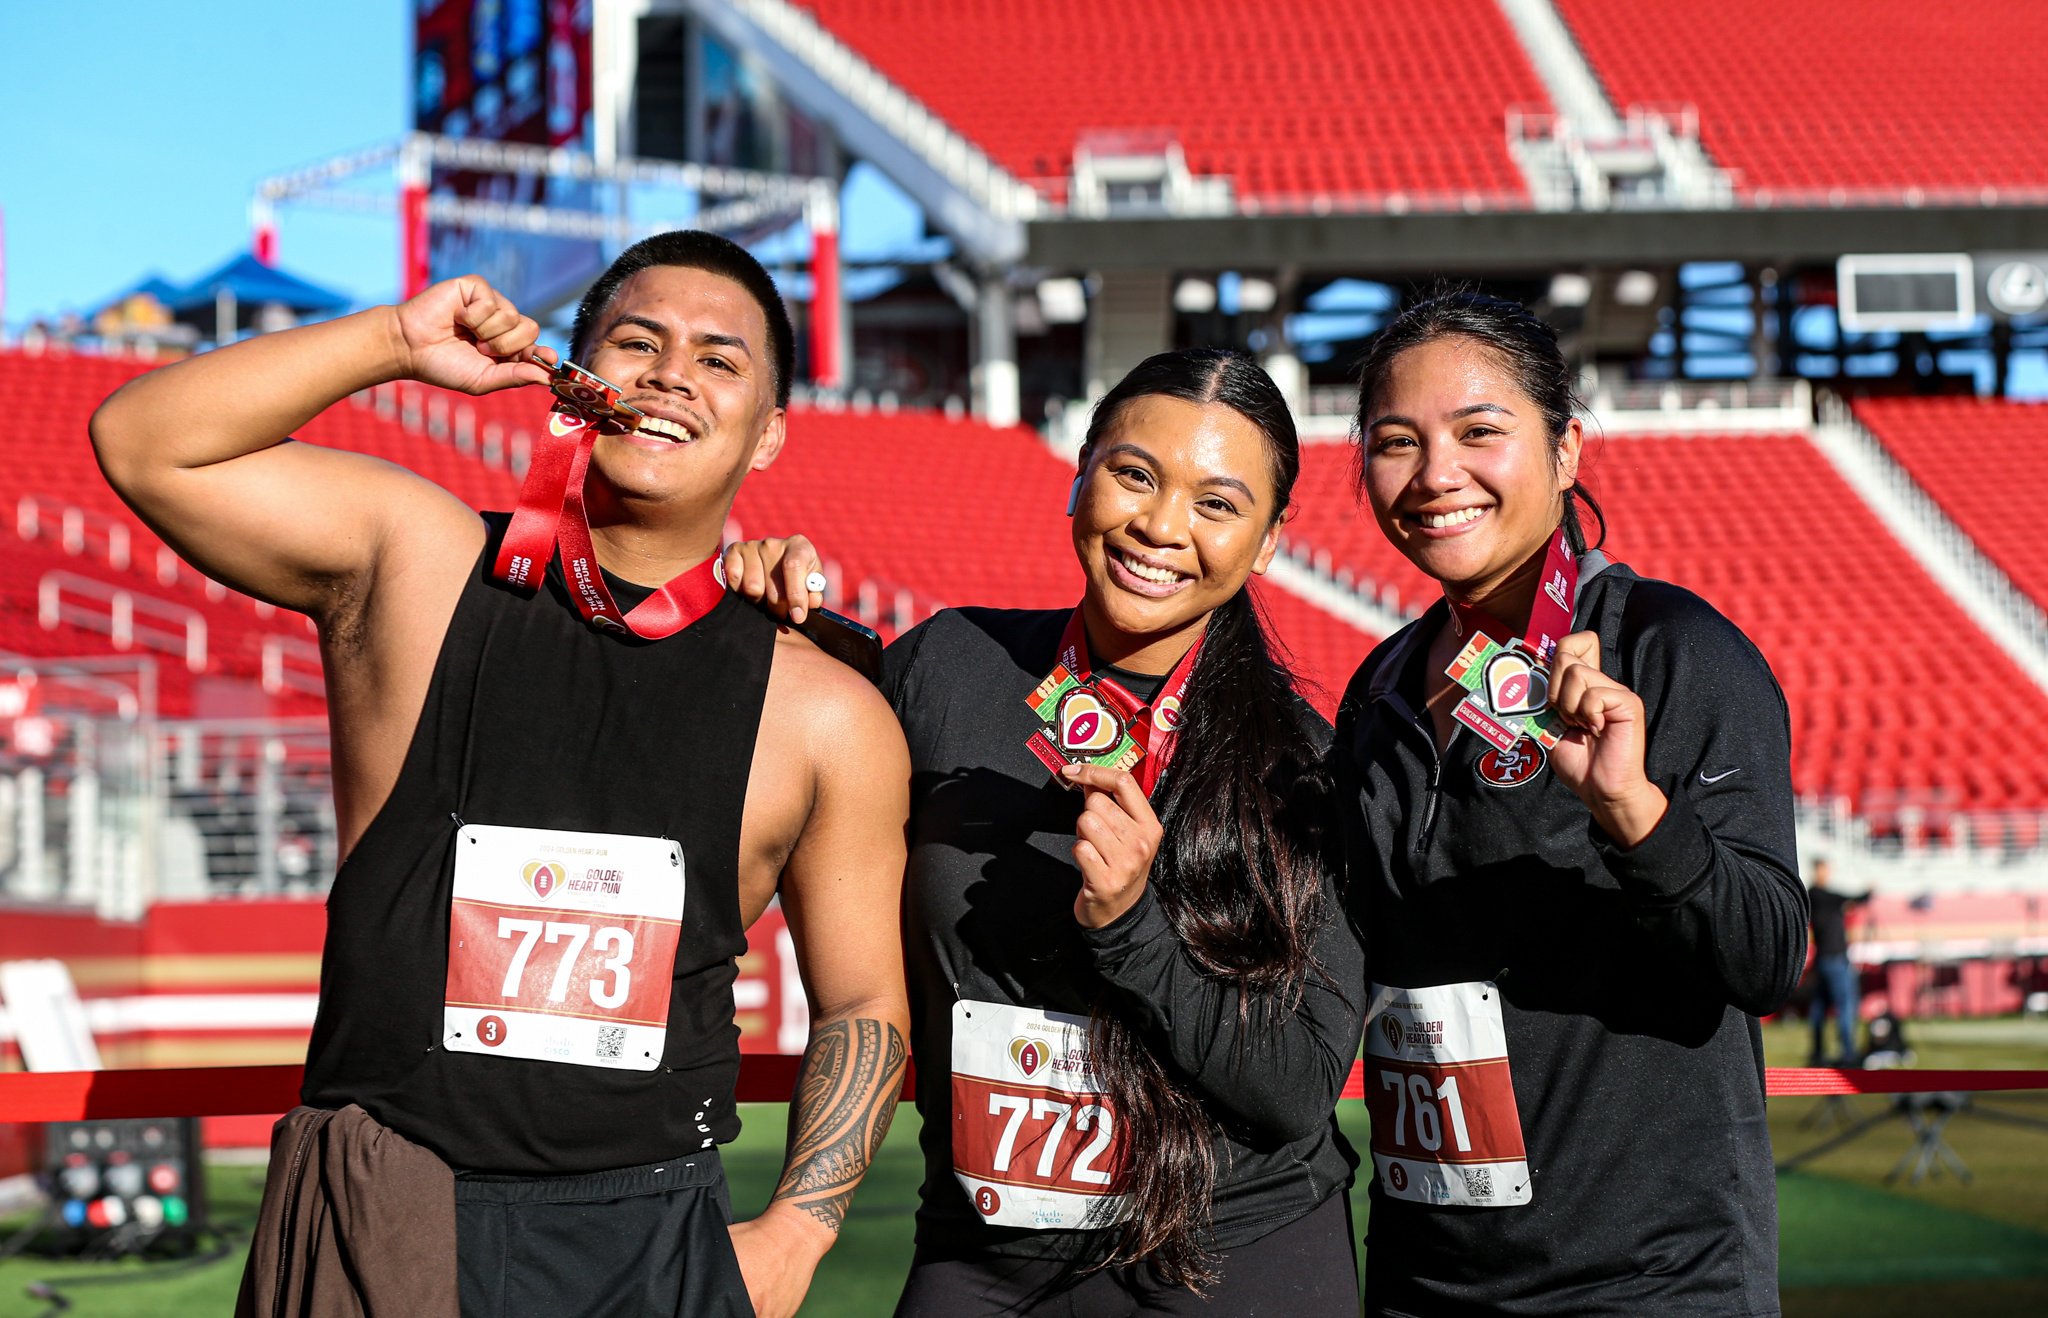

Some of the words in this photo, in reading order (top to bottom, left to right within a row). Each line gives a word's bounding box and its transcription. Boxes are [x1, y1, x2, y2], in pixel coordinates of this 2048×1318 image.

[519, 557, 532, 581] FUND
[572, 559, 588, 596] GOLDEN
[579, 557, 592, 583] FUND
[585, 596, 599, 612] THE
[587, 585, 606, 611] HEART
[1069, 645, 1077, 668] FUND
[1176, 682, 1189, 698] THE
[1043, 727, 1057, 742] 2024
[586, 868, 624, 883] GOLDEN
[568, 879, 602, 893] HEART
[600, 882, 621, 895] RUN
[498, 916, 634, 1009] 773
[485, 1021, 497, 1041] 3
[1026, 1022, 1041, 1031] 2024
[1041, 1025, 1061, 1033] GOLDEN
[1413, 1020, 1443, 1033] GOLDEN
[1406, 1033, 1426, 1044] HEART
[1426, 1033, 1443, 1045] RUN
[1052, 1057, 1081, 1073] HEART
[1081, 1062, 1094, 1075] RU
[1380, 1070, 1472, 1152] 761
[989, 1092, 1113, 1185] 772
[1394, 1167, 1402, 1185] 3
[982, 1192, 992, 1210] 3
